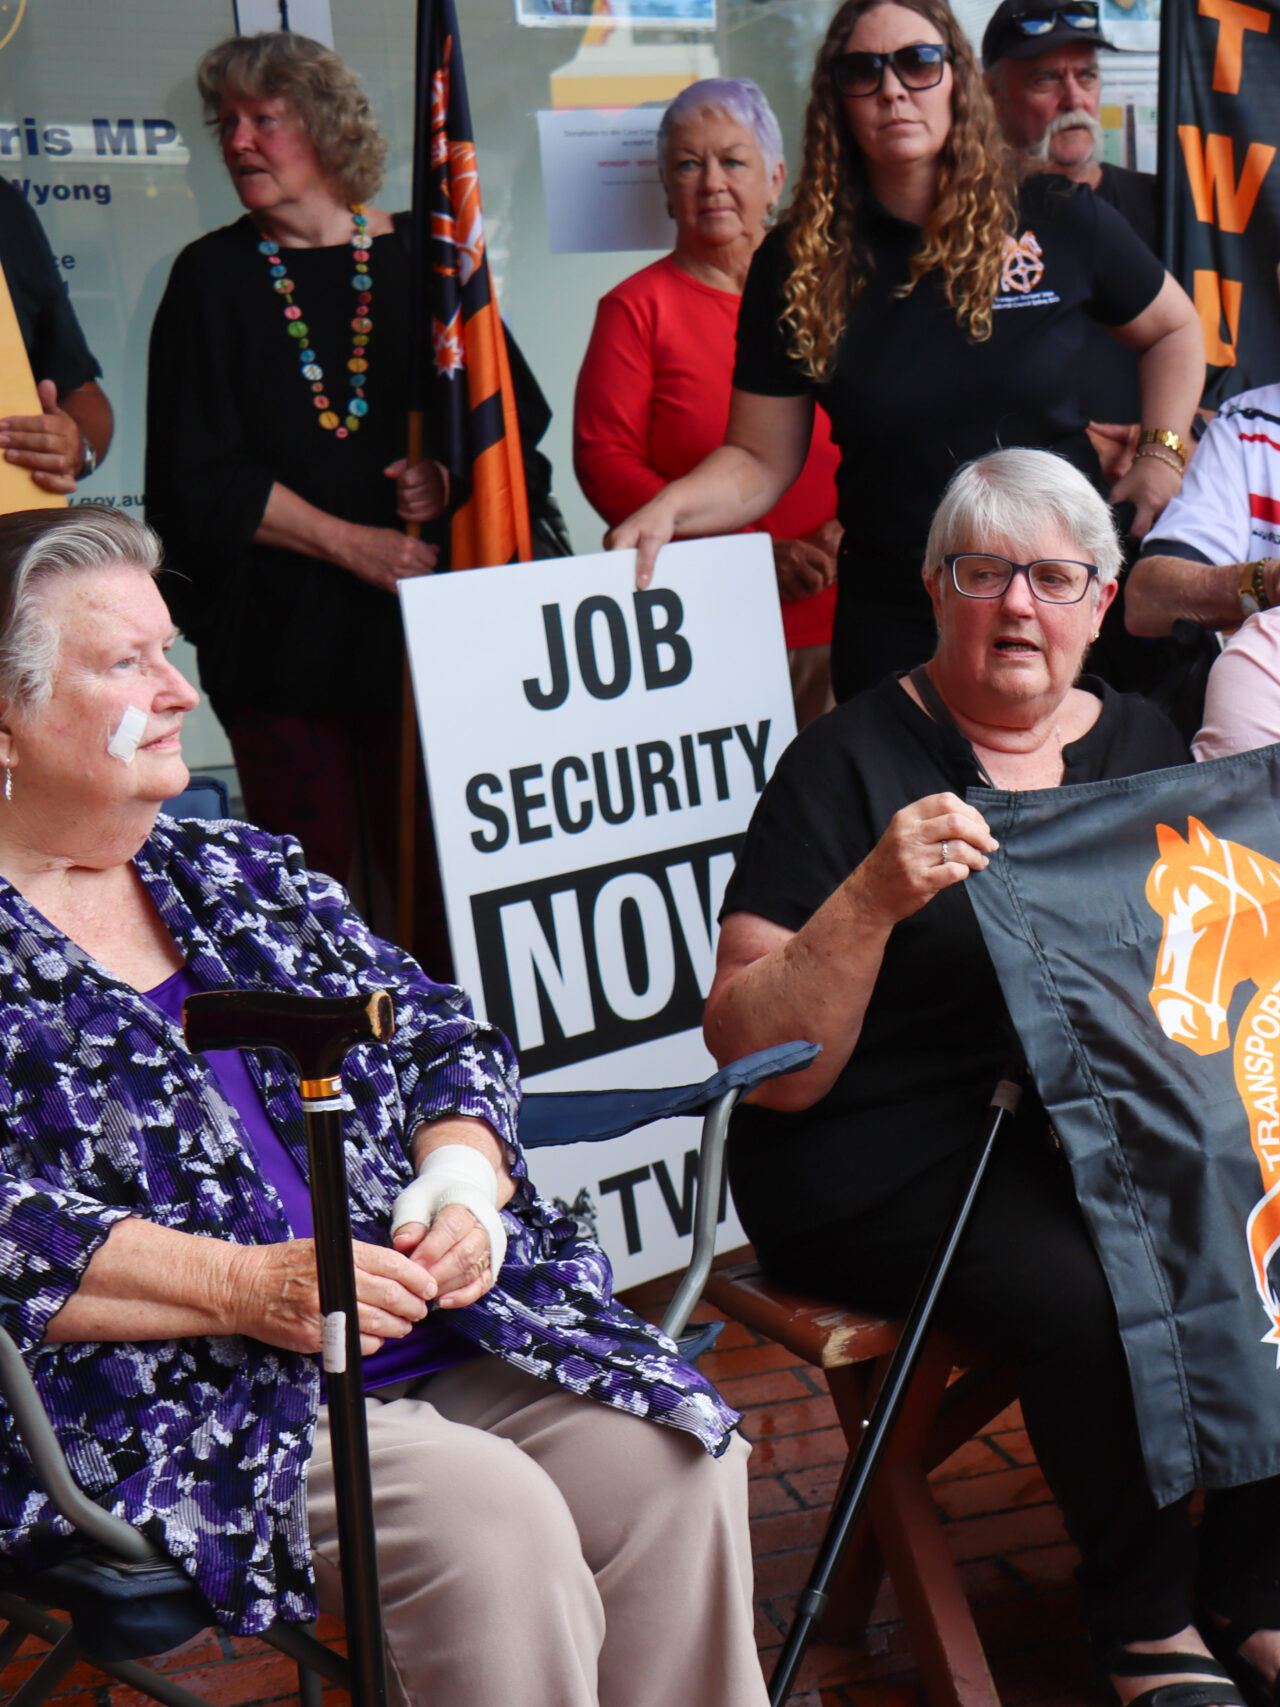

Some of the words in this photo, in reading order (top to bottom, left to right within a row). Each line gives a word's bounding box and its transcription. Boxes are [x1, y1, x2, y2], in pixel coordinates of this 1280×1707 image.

[92, 119, 177, 156] MP
[522, 587, 693, 712] JOB
[465, 719, 773, 853] SECURITY
